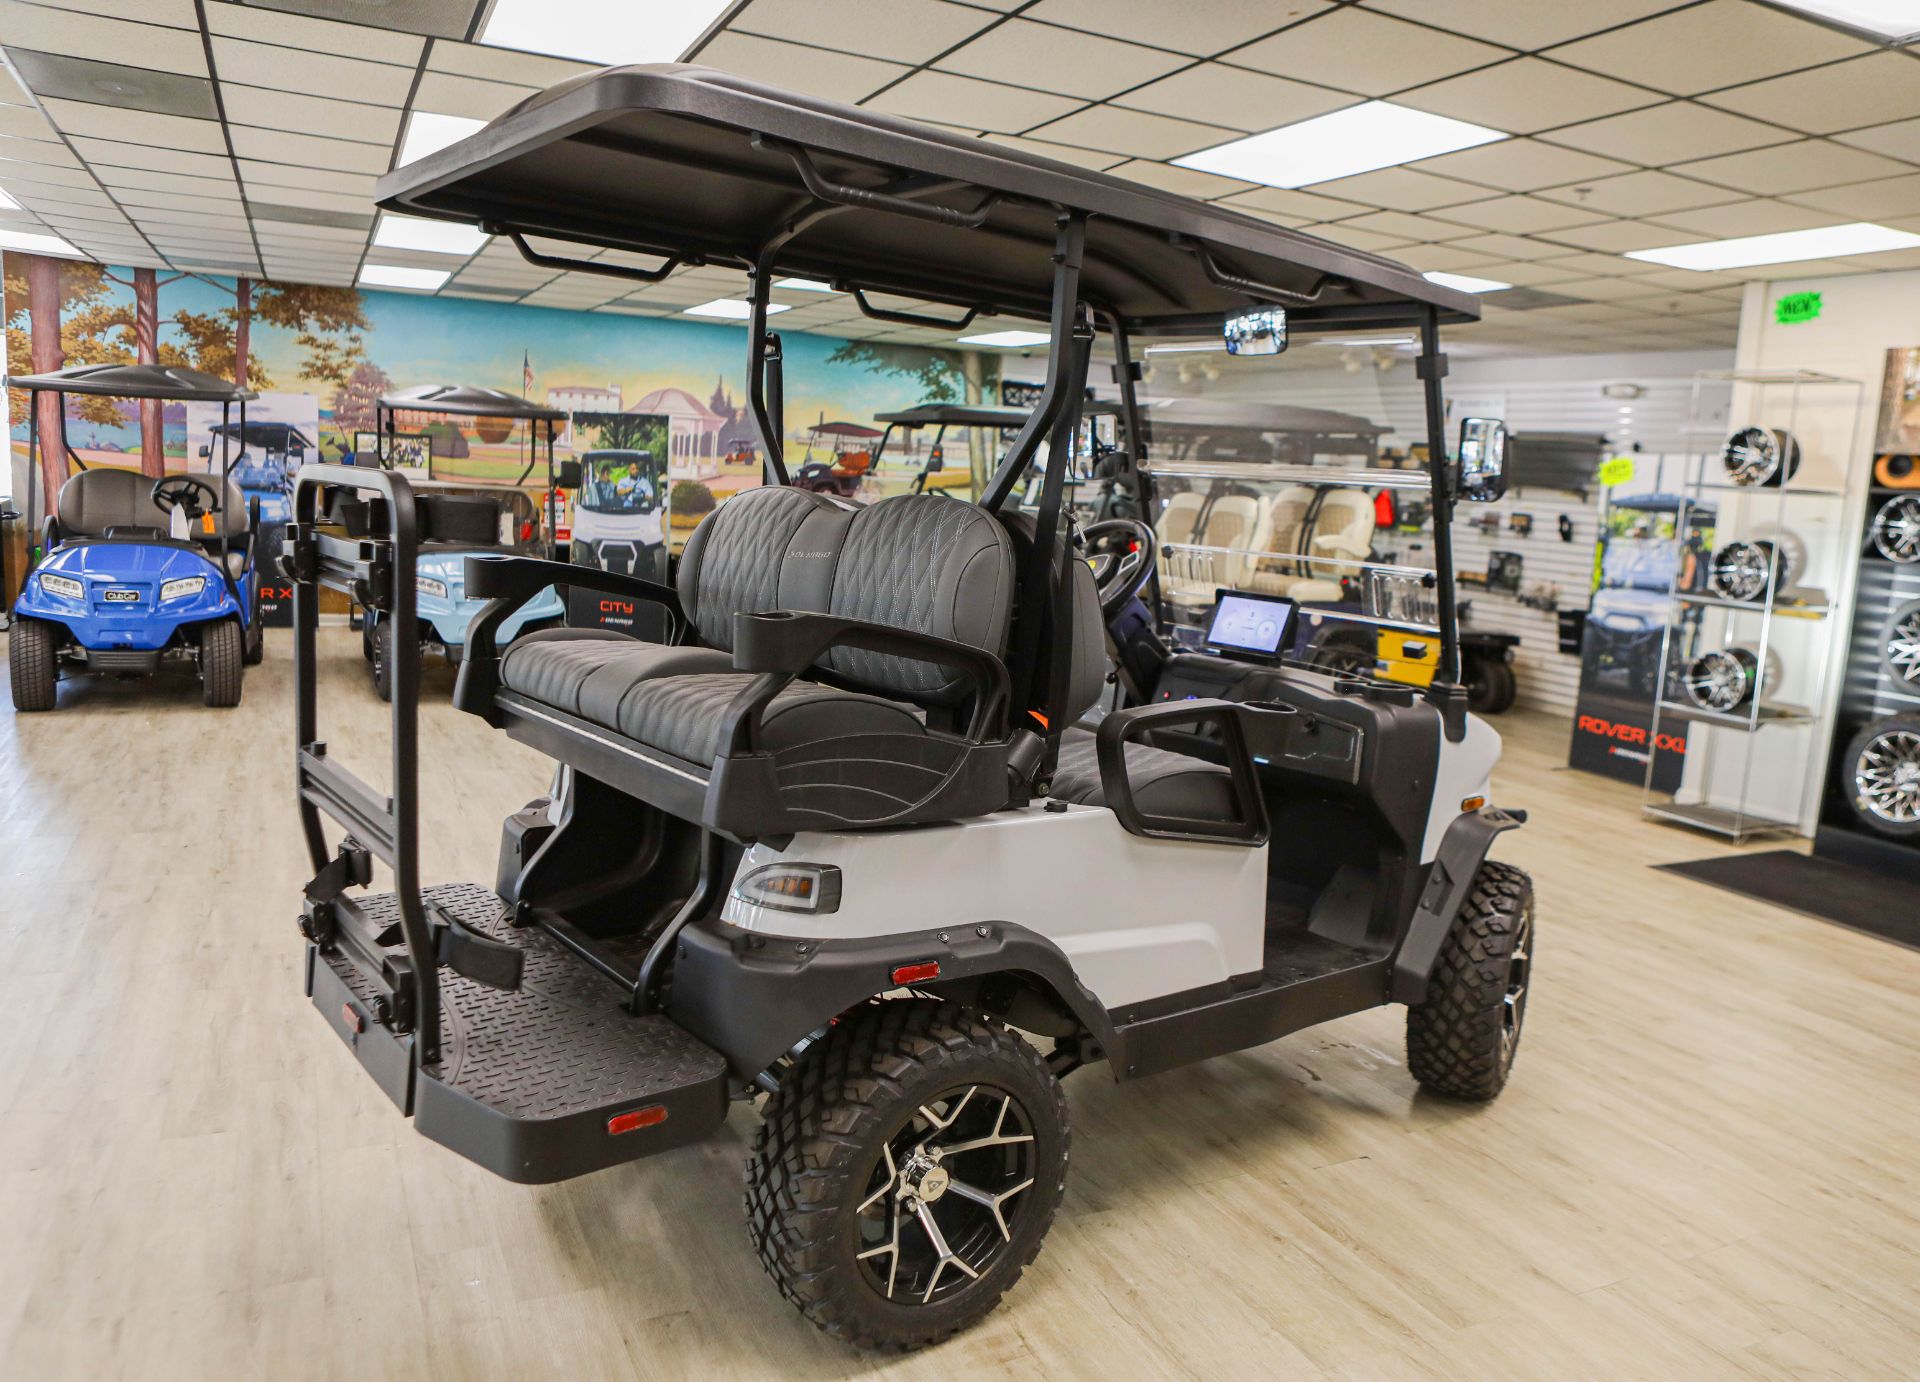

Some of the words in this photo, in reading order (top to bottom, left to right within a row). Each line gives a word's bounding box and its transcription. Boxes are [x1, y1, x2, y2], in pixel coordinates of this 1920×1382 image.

[107, 592, 124, 600] Club
[600, 600, 633, 614] CITY
[1578, 715, 1647, 745] ROVER
